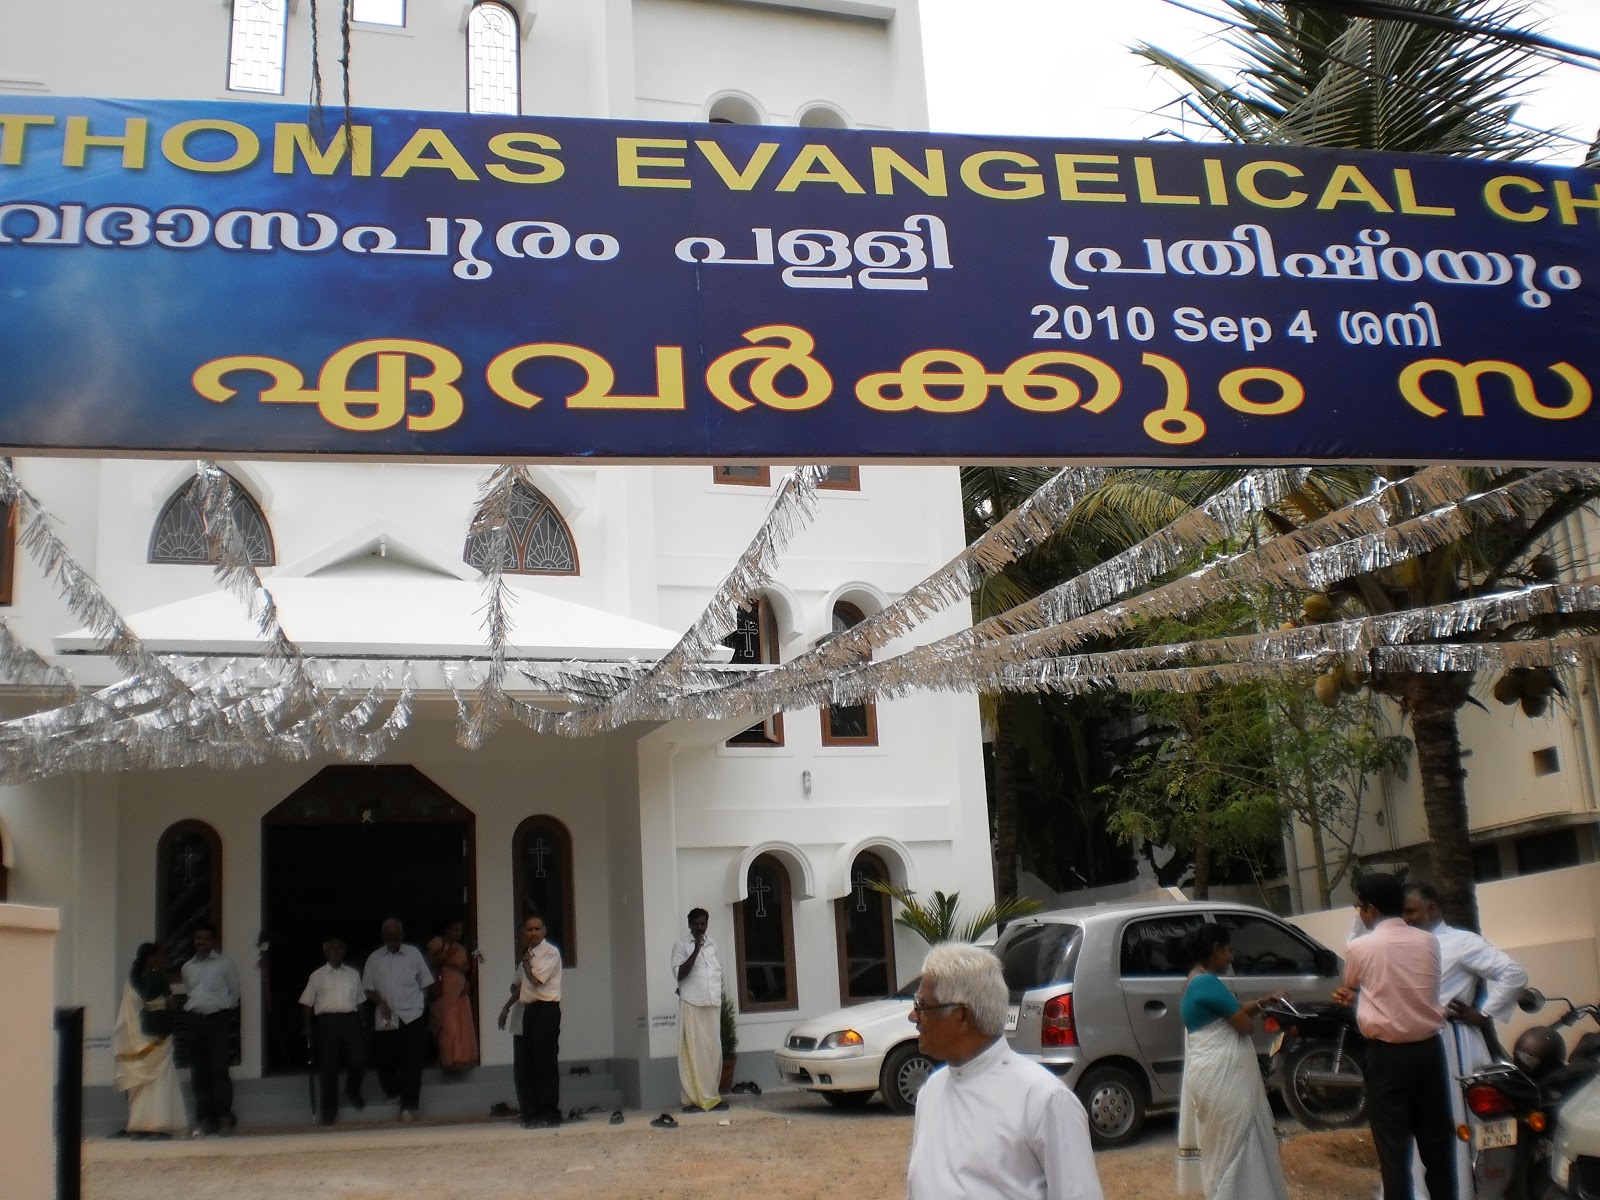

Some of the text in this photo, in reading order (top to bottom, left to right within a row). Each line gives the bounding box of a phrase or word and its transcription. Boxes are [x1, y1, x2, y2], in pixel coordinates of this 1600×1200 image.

[0, 114, 1600, 226] THOMAS EVANGELICAL CH
[674, 213, 954, 292] പള്ളി
[1047, 223, 1582, 308] പ്രതിഷ്ഠയും
[1031, 301, 1442, 352] 2010 Sep 4 ശനി
[193, 325, 1592, 444] ഏവർക്കും സ
